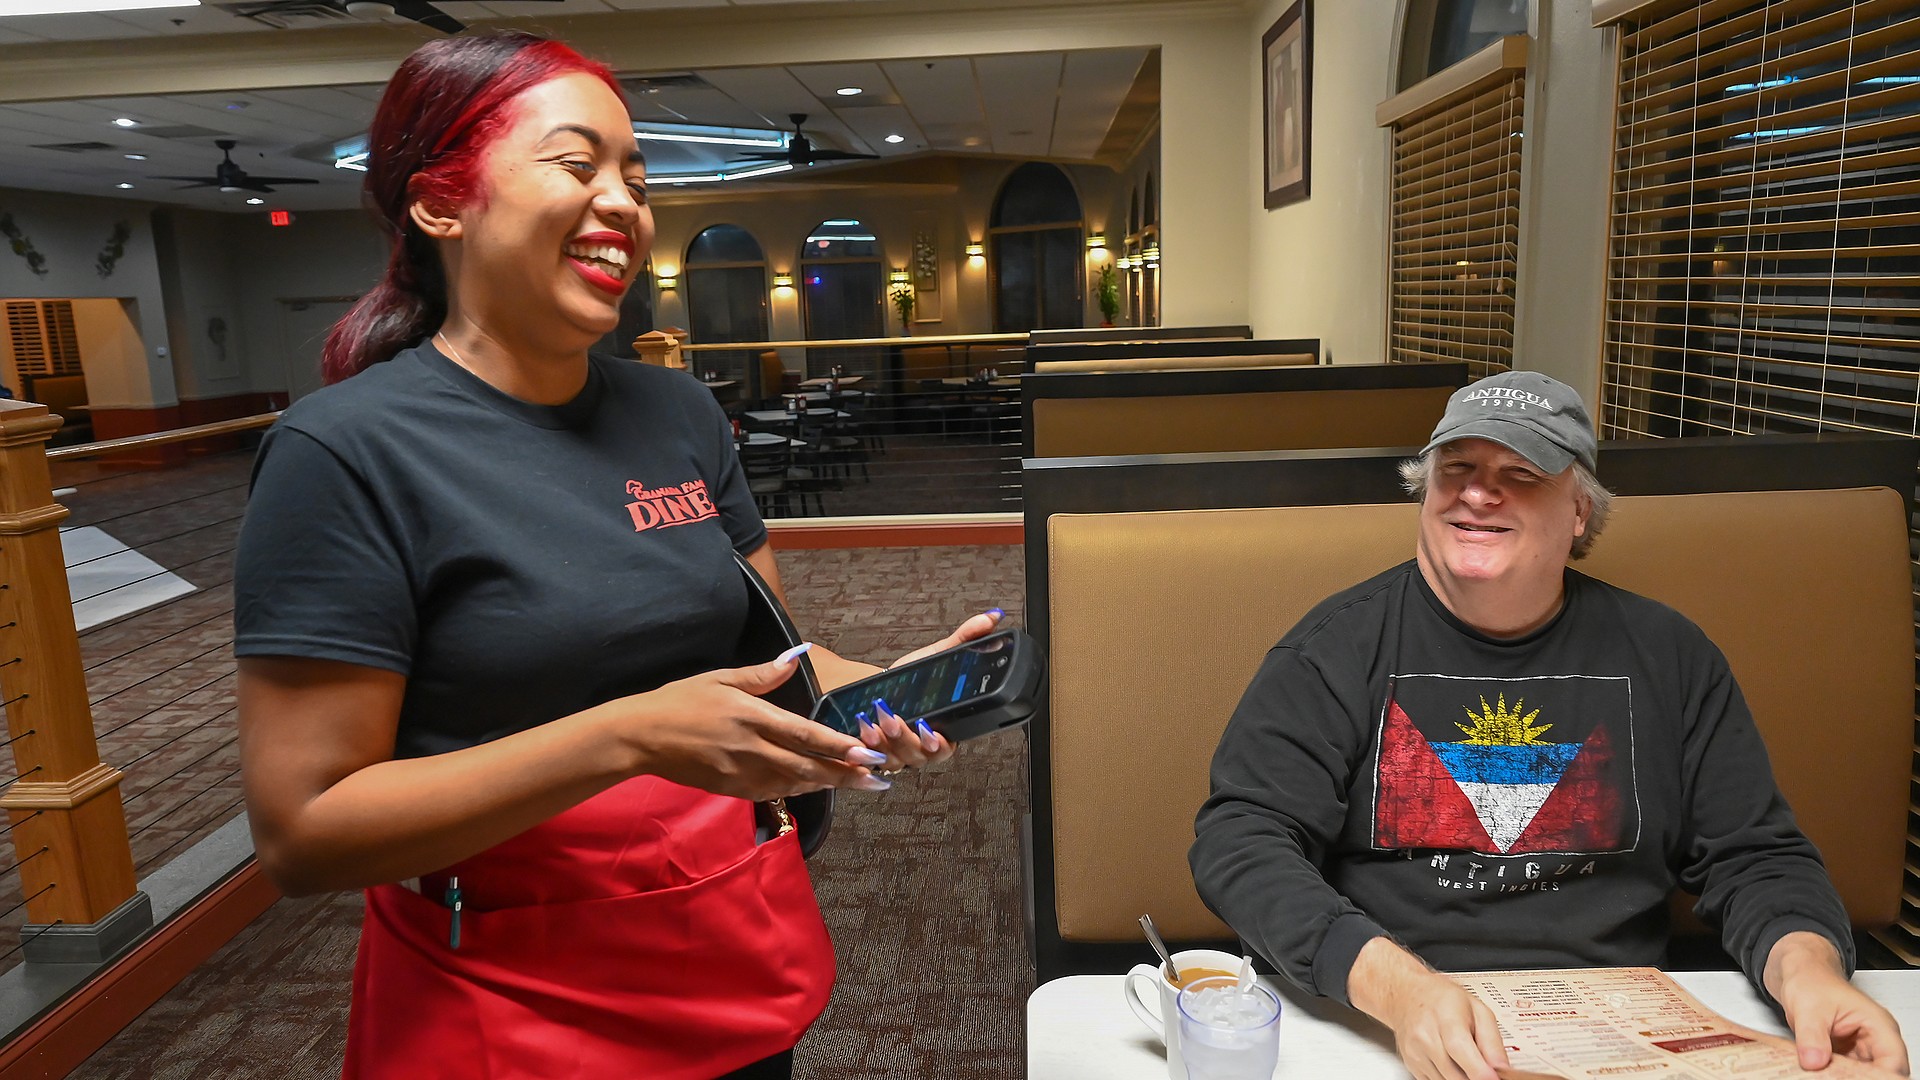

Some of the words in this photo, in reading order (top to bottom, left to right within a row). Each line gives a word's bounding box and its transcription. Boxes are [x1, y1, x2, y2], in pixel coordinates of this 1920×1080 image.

[1462, 387, 1553, 411] ANTIGUA
[1481, 398, 1526, 410] 1981
[624, 488, 717, 532] DINE
[1438, 877, 1488, 891] WEST
